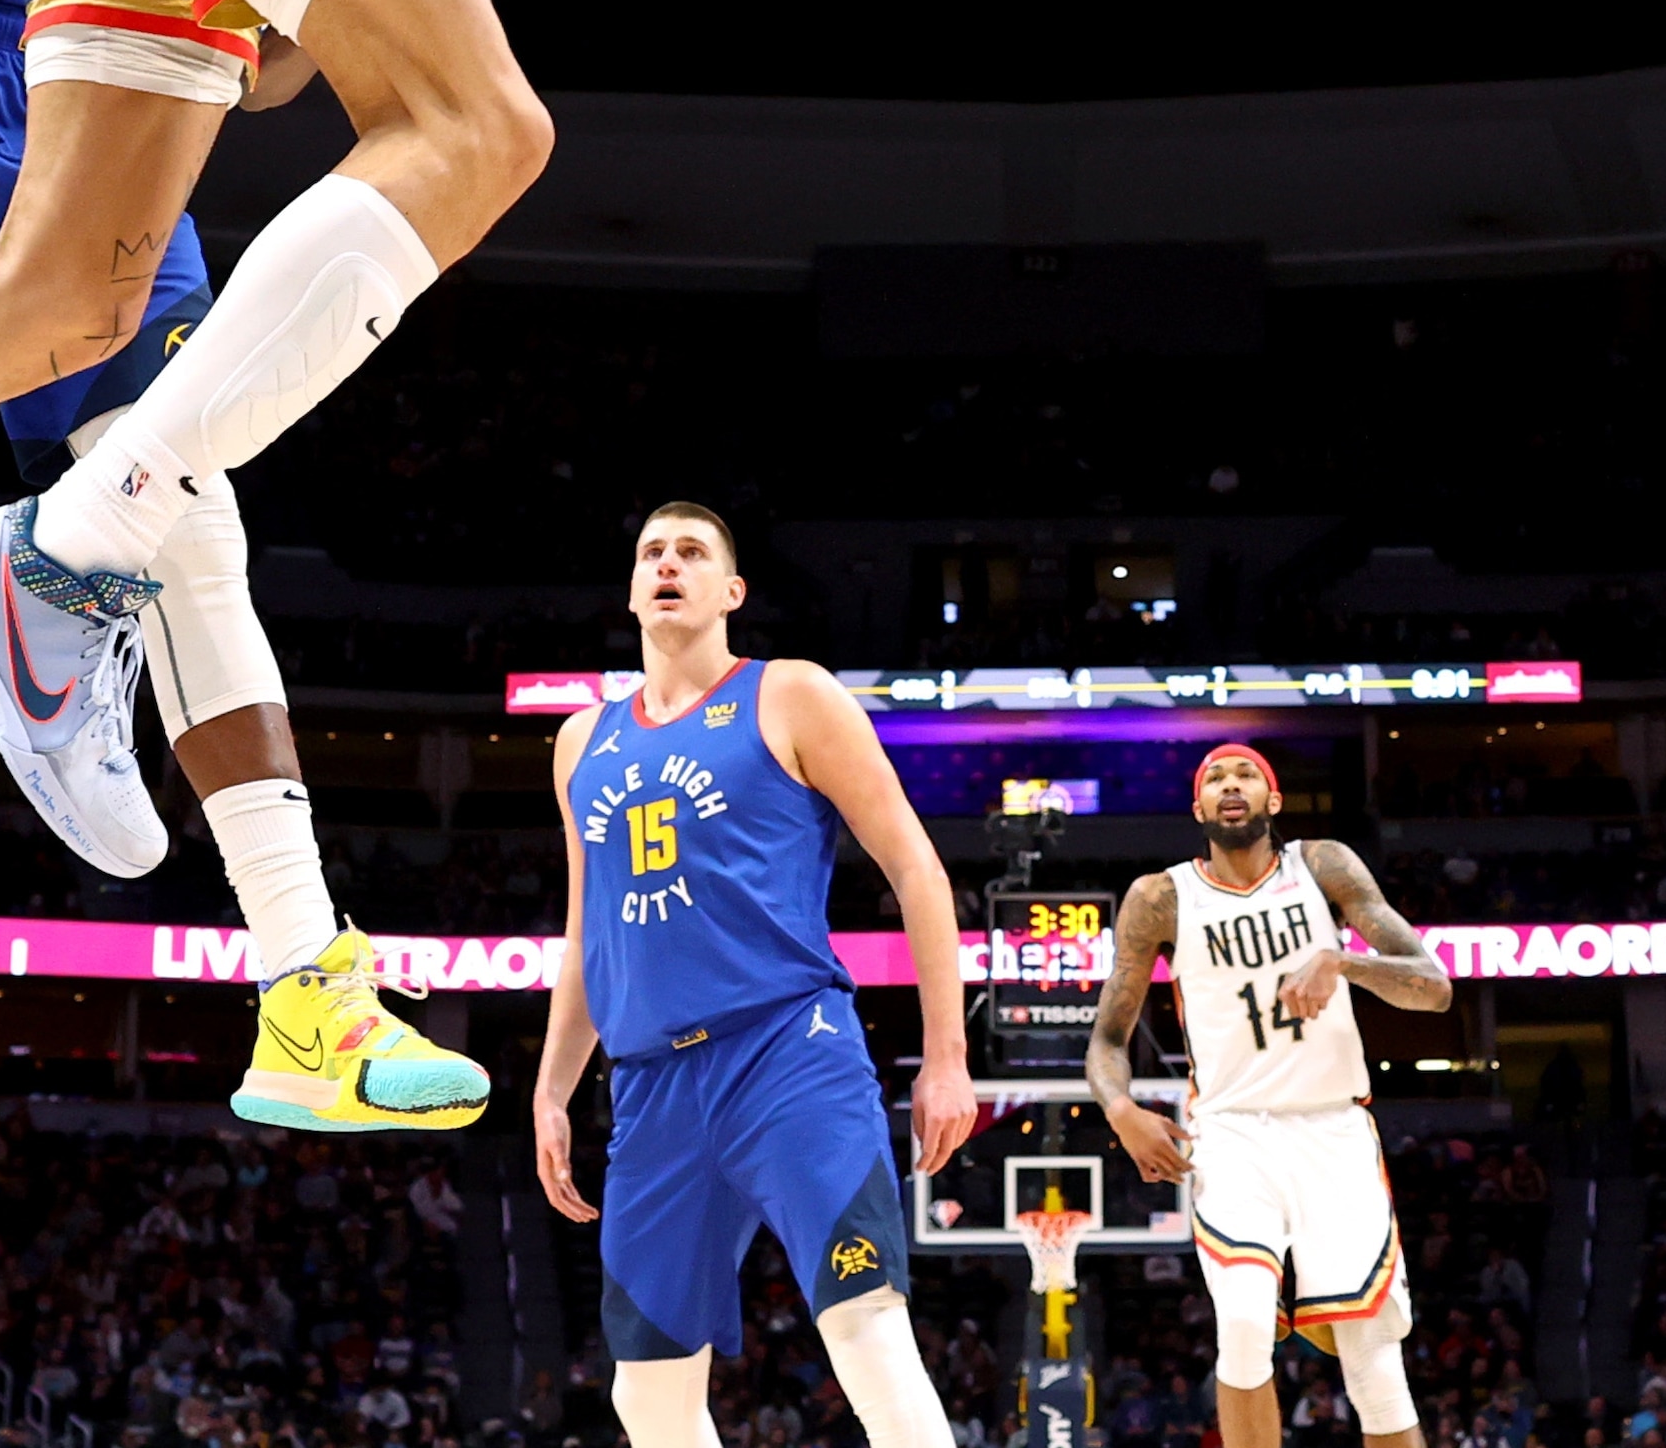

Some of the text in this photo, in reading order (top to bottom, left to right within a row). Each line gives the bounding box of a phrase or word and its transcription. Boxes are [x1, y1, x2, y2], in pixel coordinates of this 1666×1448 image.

[583, 753, 728, 845] MILE HIGH
[625, 796, 678, 877] 15
[620, 875, 694, 926] CITY
[1029, 903, 1100, 940] 3:30
[1202, 902, 1313, 970] NOLA
[1237, 973, 1305, 1052] 14
